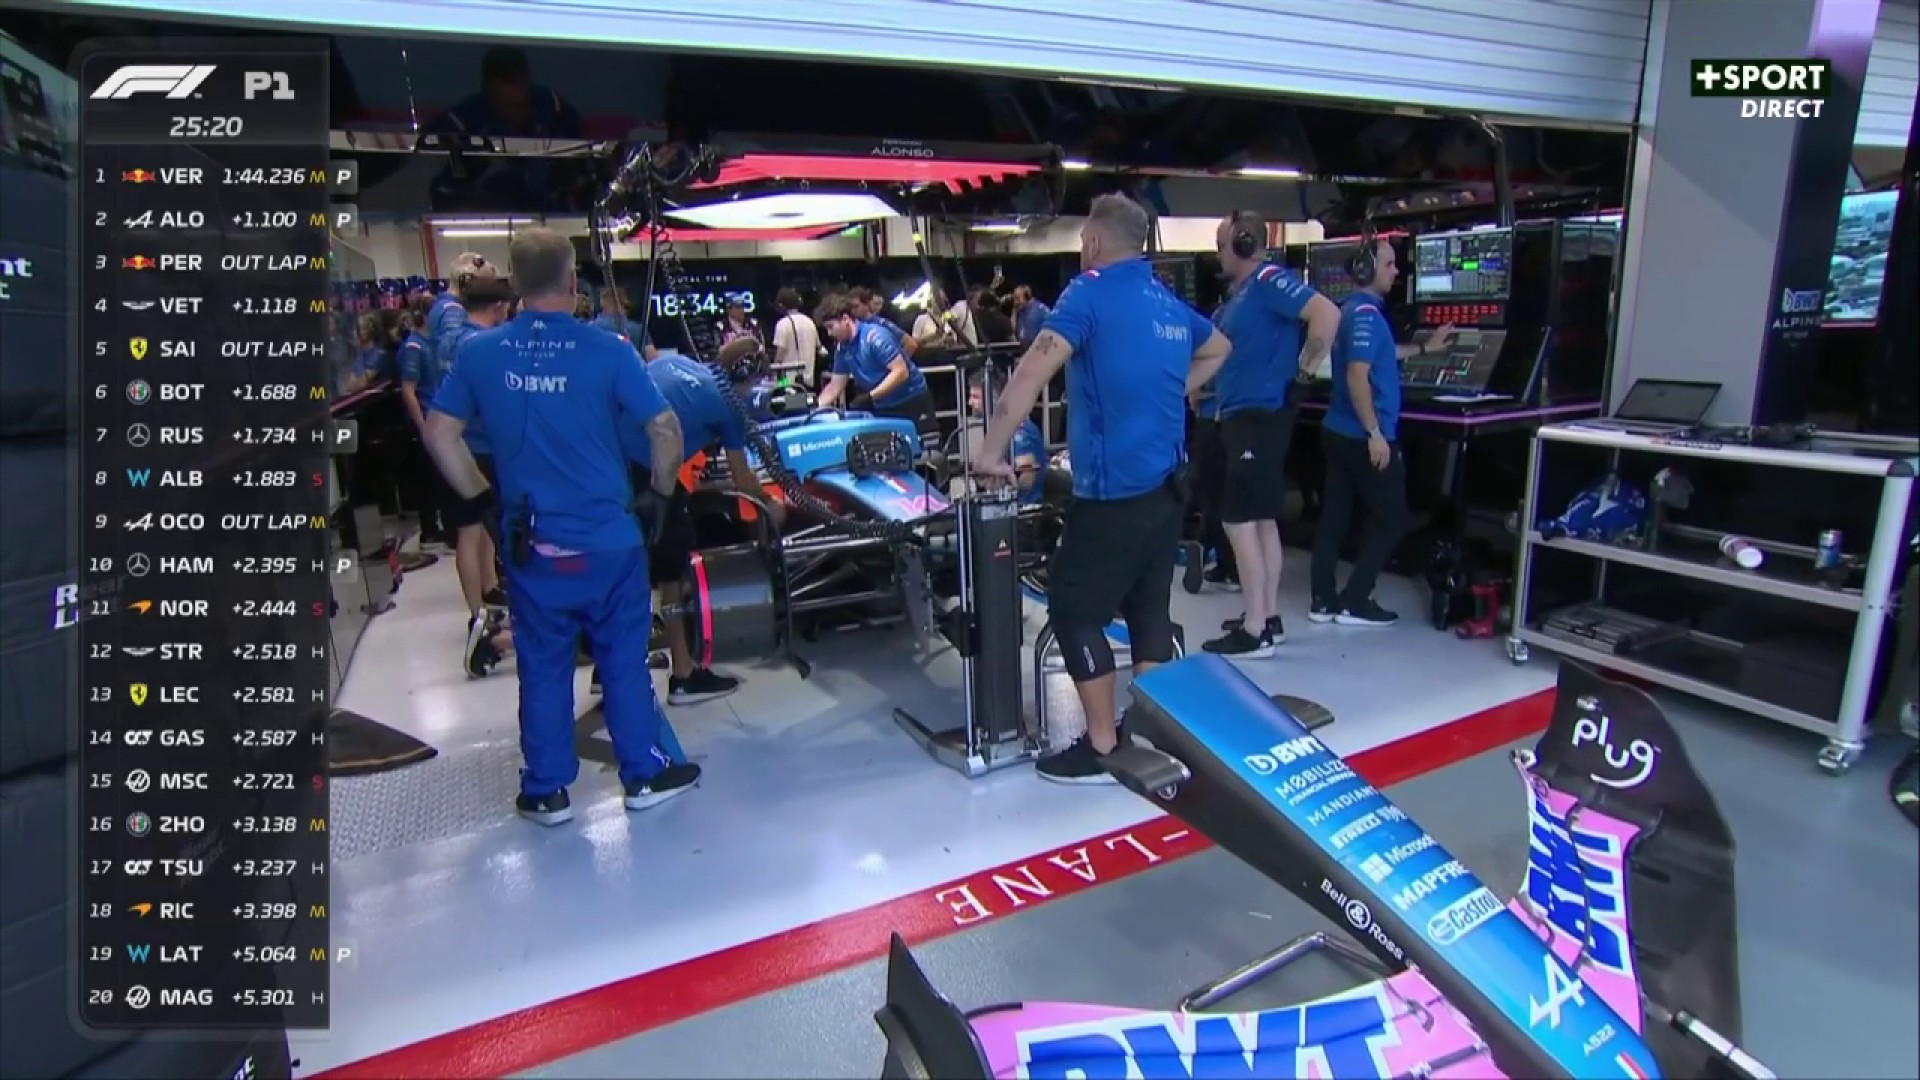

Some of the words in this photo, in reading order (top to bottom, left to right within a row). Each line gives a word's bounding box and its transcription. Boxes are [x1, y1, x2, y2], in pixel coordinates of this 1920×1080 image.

[872, 146, 934, 158] ALONSO
[500, 338, 577, 350] ALPINE
[524, 373, 568, 393] BWT
[1269, 735, 1325, 765] BWT
[1571, 715, 1655, 789] plug
[1320, 878, 1348, 908] Bell
[1368, 922, 1404, 960] Ross
